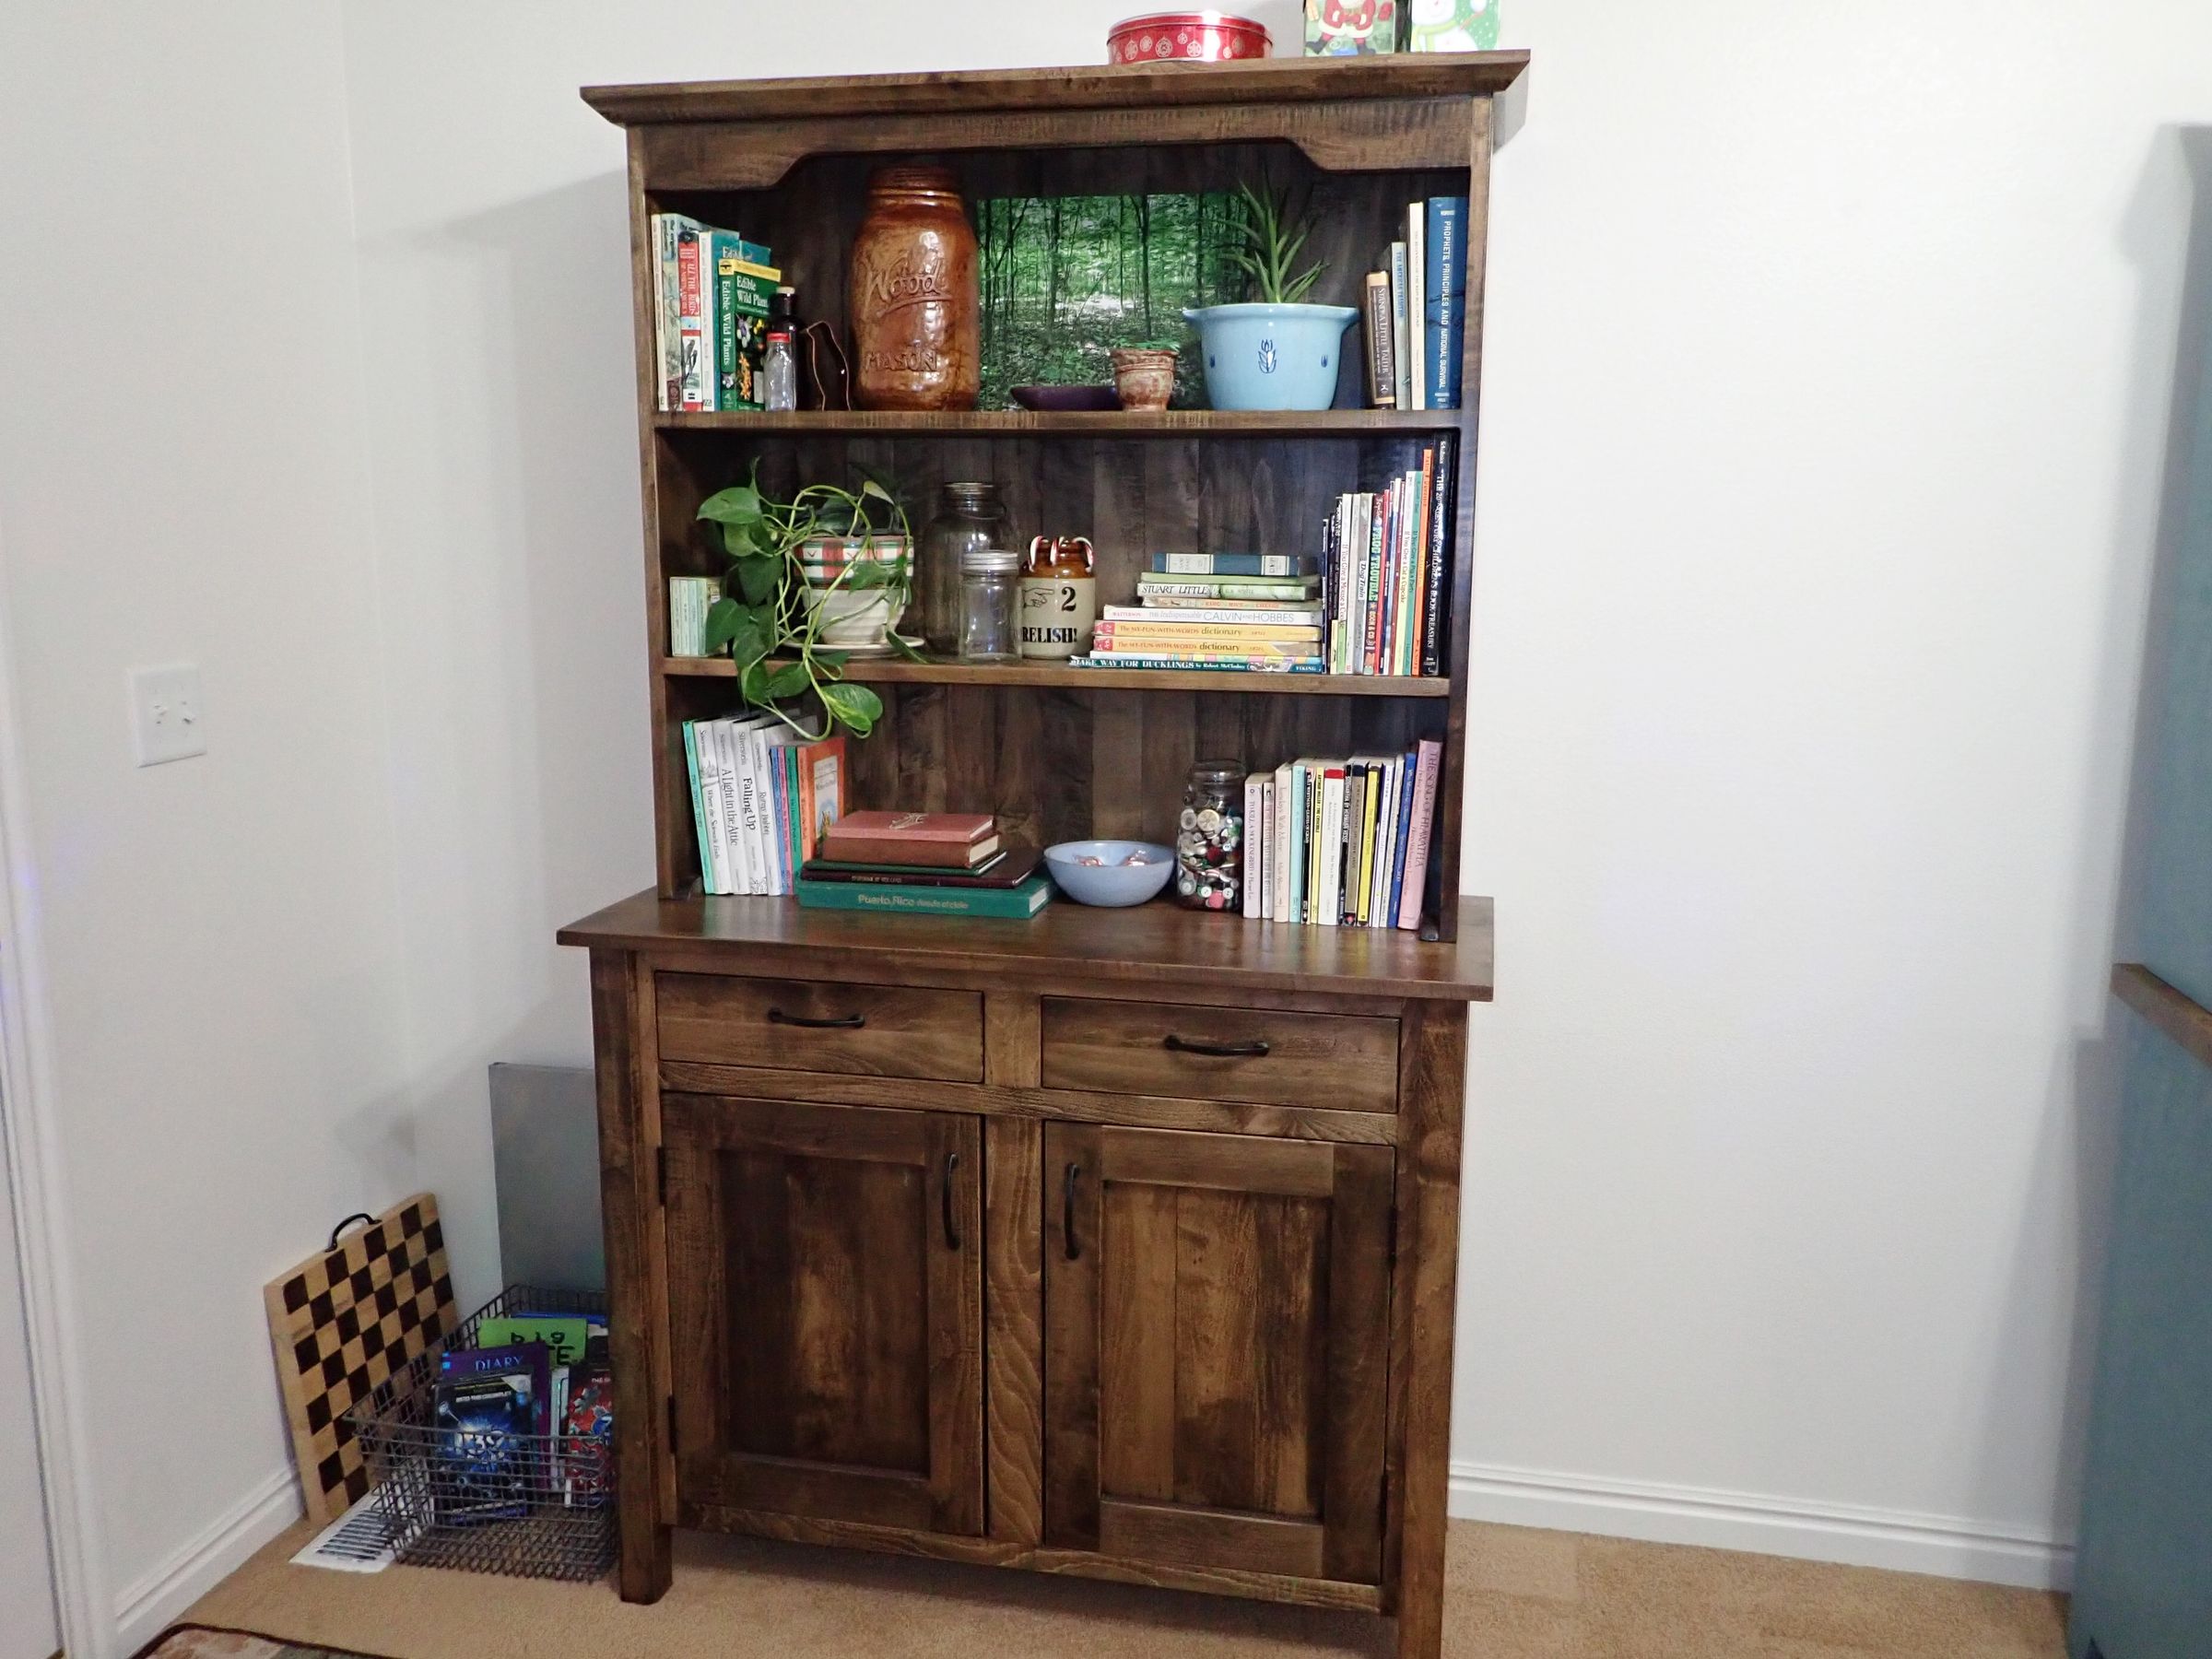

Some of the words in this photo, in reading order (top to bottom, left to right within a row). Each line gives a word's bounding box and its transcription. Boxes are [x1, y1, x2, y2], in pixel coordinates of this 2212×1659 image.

[736, 276, 756, 291] Edible
[1441, 263, 1451, 307] PRINCIPLES
[723, 280, 731, 311] Edible
[736, 290, 752, 304] Wild
[723, 313, 732, 335] Wild
[1441, 309, 1449, 325] AND
[1379, 323, 1388, 346] LITTLE
[1440, 327, 1448, 359] NATIONAL
[723, 338, 732, 365] Plants
[1381, 347, 1390, 373] TALLER
[1438, 359, 1447, 389] SURVIVAL
[1436, 475, 1445, 491] THE
[1371, 525, 1382, 553] FROG
[1368, 554, 1381, 601] TROUBLE
[1061, 586, 1077, 612] 2
[1142, 585, 1173, 594] STUART
[1179, 585, 1209, 595] LITTLE
[1429, 590, 1437, 611] BOOK
[1204, 611, 1242, 621] CALVIN
[1253, 612, 1295, 622] HOBBES
[1021, 627, 1077, 643] RELISH!
[1201, 627, 1241, 636] dictionary
[1427, 612, 1436, 649] TREASURY
[1199, 642, 1240, 652] dictionary
[1072, 658, 1097, 666] MAKE
[1100, 659, 1119, 667] WAY
[1142, 661, 1194, 669] DUCKLINGS
[722, 768, 732, 776] A
[1428, 752, 1437, 772] THE
[723, 777, 734, 799] Light
[742, 777, 753, 814] Falling
[1425, 773, 1436, 800] SONG
[726, 800, 735, 808] in
[1422, 801, 1431, 815] OF
[727, 810, 737, 825] the
[746, 816, 756, 830] Up
[728, 825, 739, 845] Attic
[1415, 816, 1430, 867] HIAWATHA
[858, 894, 890, 905] Puerto
[892, 895, 914, 906] Rico
[475, 1355, 524, 1371] DIARY
